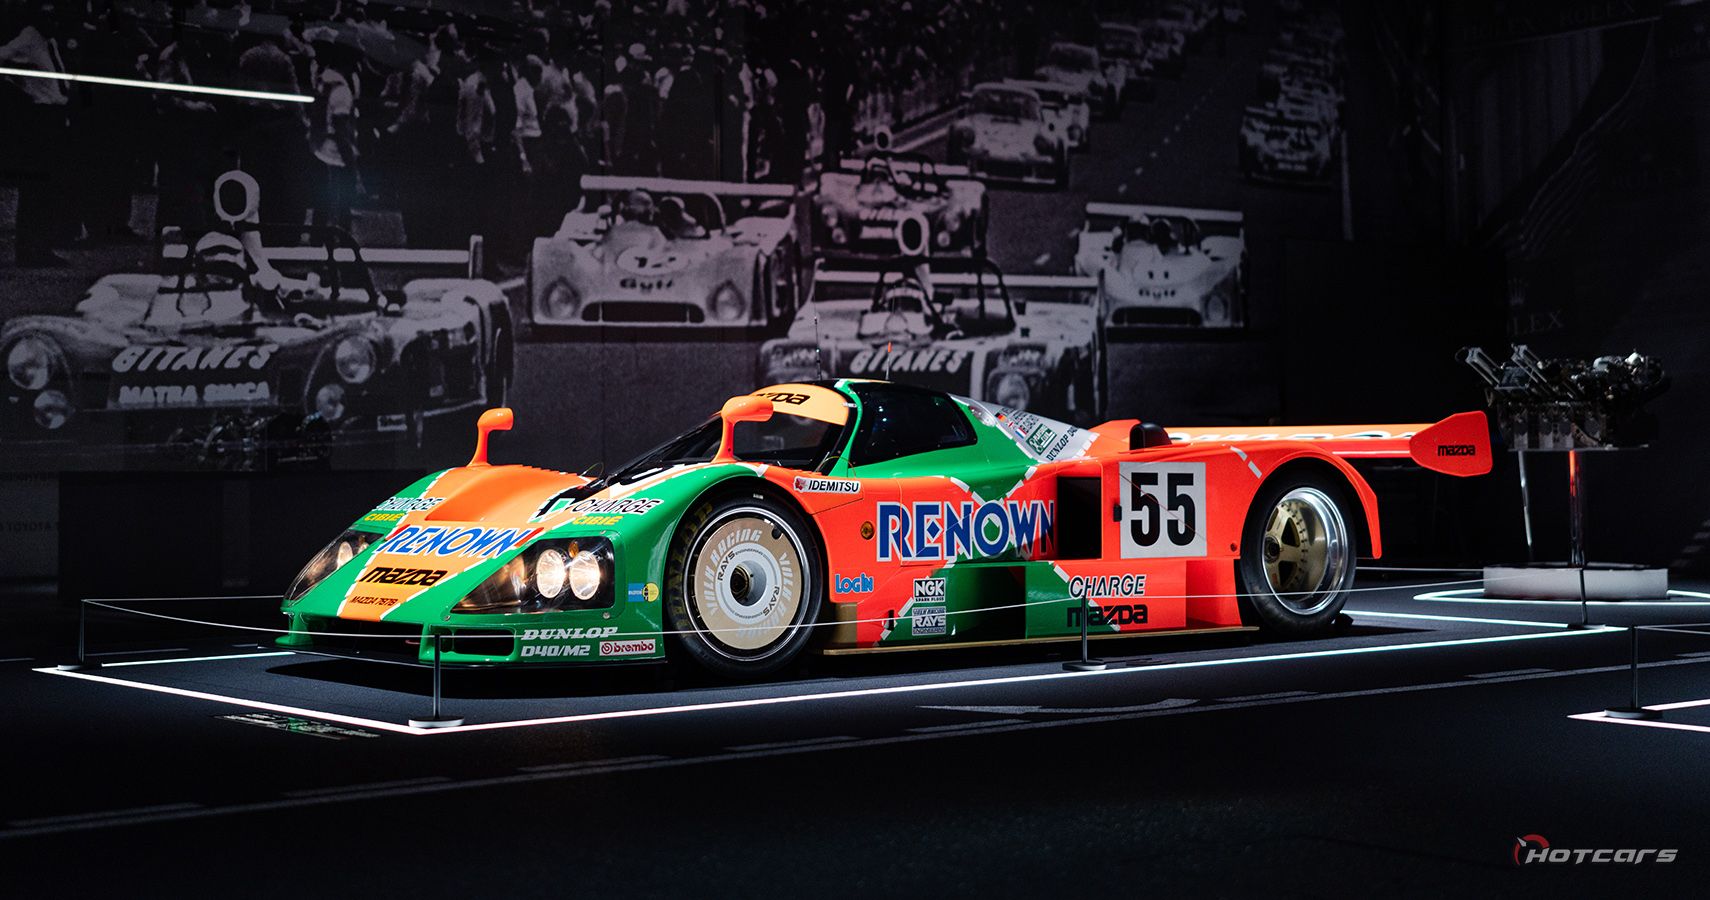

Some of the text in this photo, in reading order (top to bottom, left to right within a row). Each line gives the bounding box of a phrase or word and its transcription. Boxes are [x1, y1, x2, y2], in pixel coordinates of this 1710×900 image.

[112, 344, 279, 373] GITANES
[850, 350, 969, 374] GITANES
[1046, 434, 1069, 461] DUNLOP
[1437, 445, 1475, 456] mazda
[808, 480, 860, 492] IDEMITSU
[571, 499, 662, 514] CHARGE
[1131, 472, 1196, 546] 55
[374, 526, 533, 558] RENOWN
[876, 501, 1054, 562] RENOWN
[358, 566, 448, 587] mazda
[717, 550, 736, 581] RAYS
[915, 580, 944, 597] NGK
[1070, 574, 1147, 598] CHARGE
[913, 615, 946, 628] RAYS
[1067, 604, 1148, 627] mazda
[521, 626, 618, 640] DUNLOP
[521, 645, 591, 657] D40/M2
[614, 641, 655, 653] brembo
